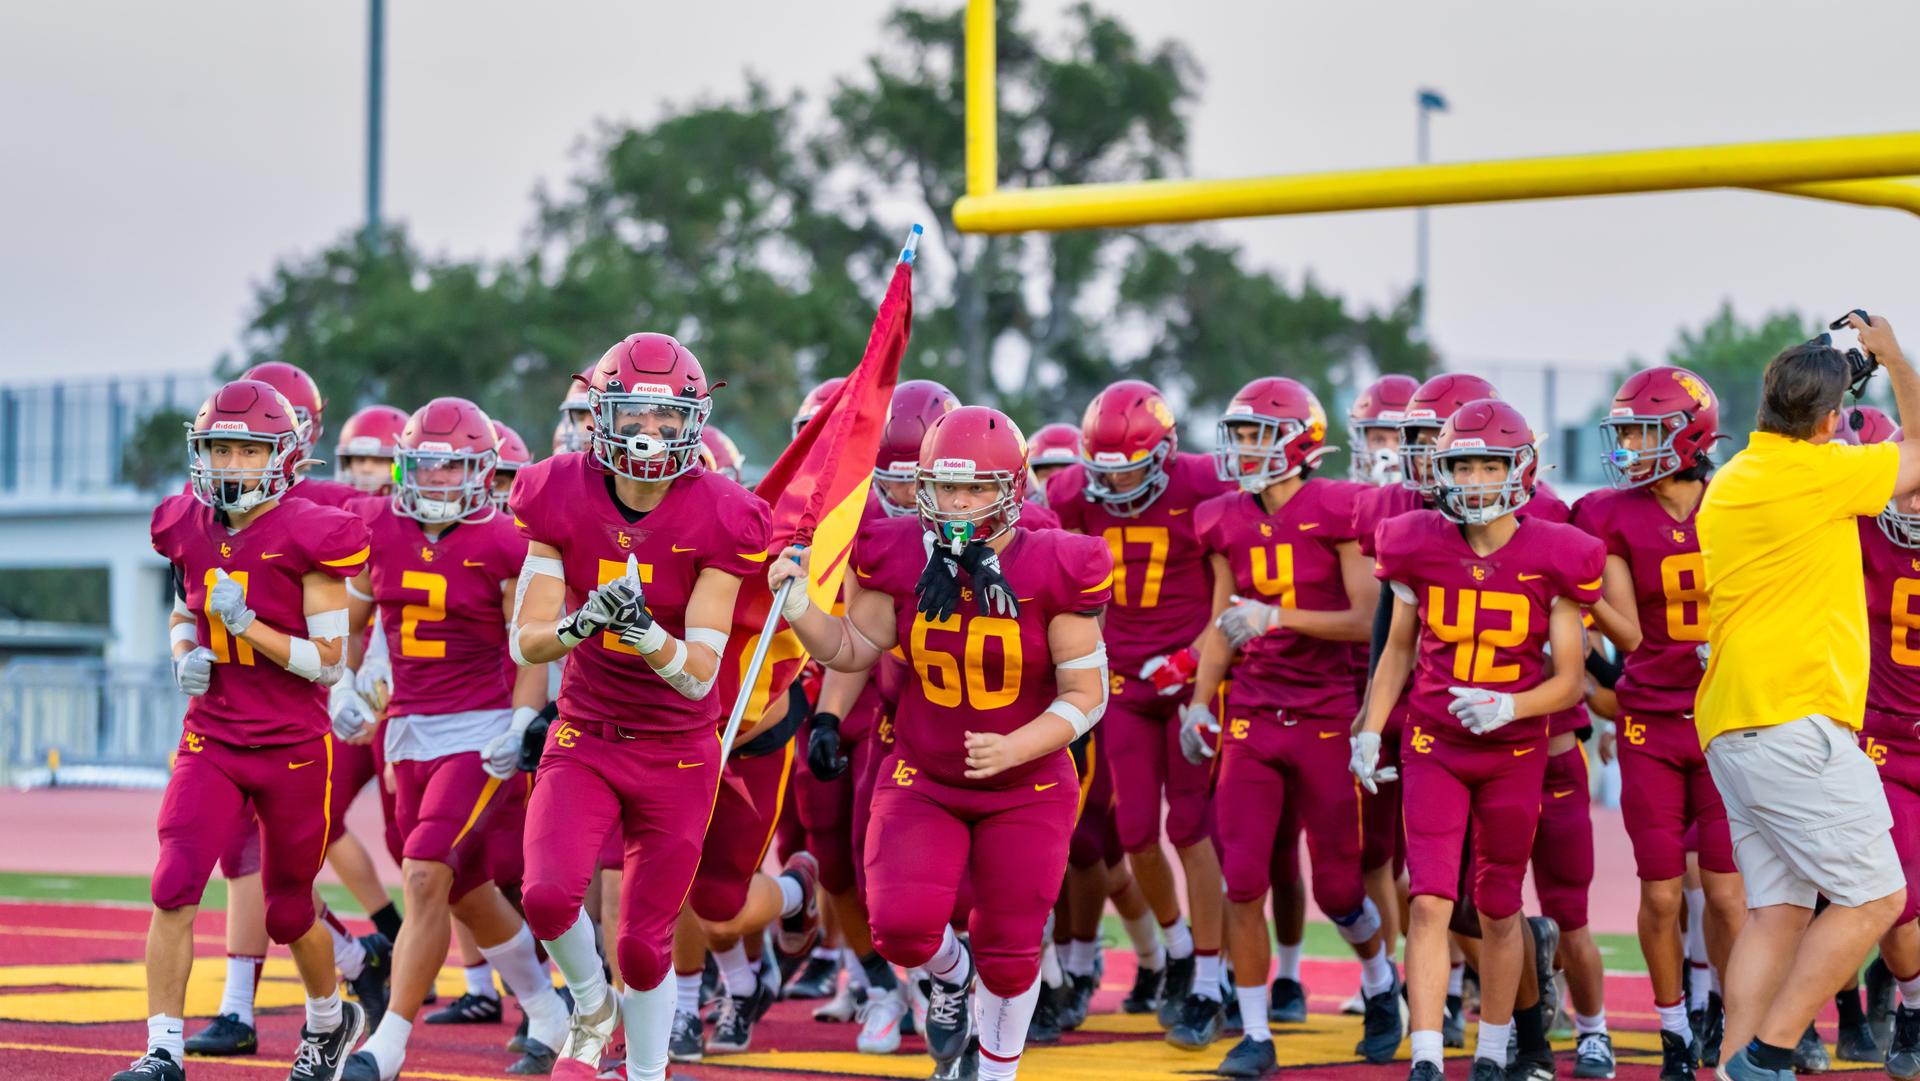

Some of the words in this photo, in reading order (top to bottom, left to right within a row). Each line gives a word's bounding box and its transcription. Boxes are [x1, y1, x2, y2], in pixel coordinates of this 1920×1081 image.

[943, 460, 966, 469] Riddell
[220, 542, 232, 558] LC
[617, 531, 631, 548] LC
[1102, 526, 1169, 608] 17
[1249, 543, 1297, 609] 4
[1472, 565, 1486, 581] LC
[961, 586, 973, 602] LC
[400, 570, 448, 658] 2
[1427, 585, 1531, 683] 42
[910, 611, 1023, 711] 60
[554, 721, 582, 748] LC
[1229, 717, 1251, 739] LC
[1410, 726, 1436, 754] LC
[1623, 715, 1647, 746] LC
[1865, 736, 1888, 766] LC
[892, 759, 918, 787] LC
